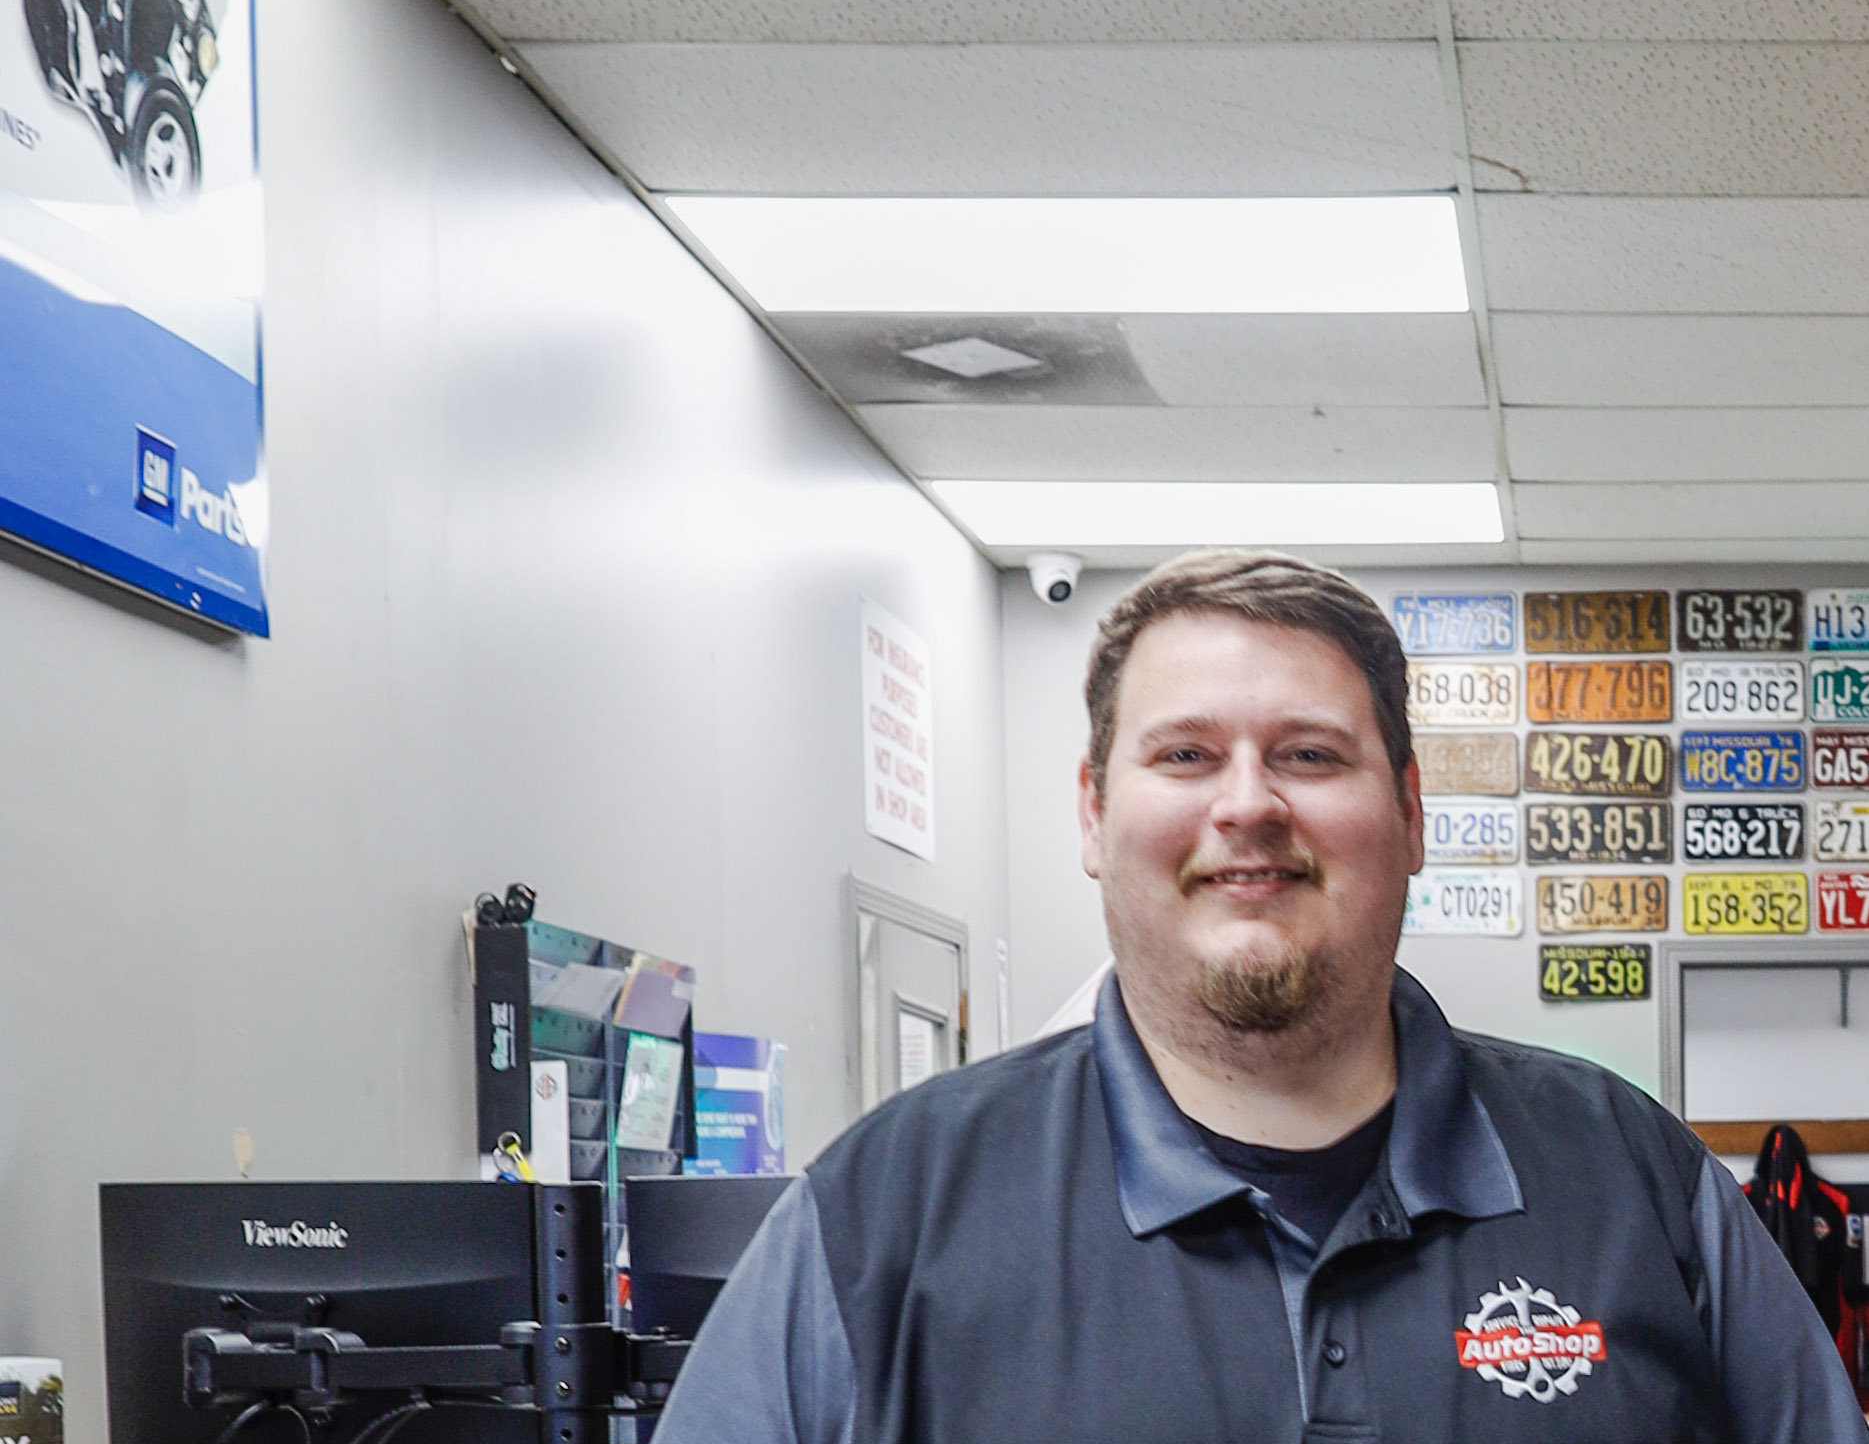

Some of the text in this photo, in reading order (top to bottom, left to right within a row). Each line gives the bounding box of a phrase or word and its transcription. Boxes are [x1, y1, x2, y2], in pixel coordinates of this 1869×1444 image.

[1712, 736, 1771, 747] MISSOURI
[1711, 807, 1733, 819] MO
[1755, 807, 1800, 819] TRUCK
[241, 1219, 349, 1248] ViewSonic
[1462, 1331, 1601, 1360] AutoShop
